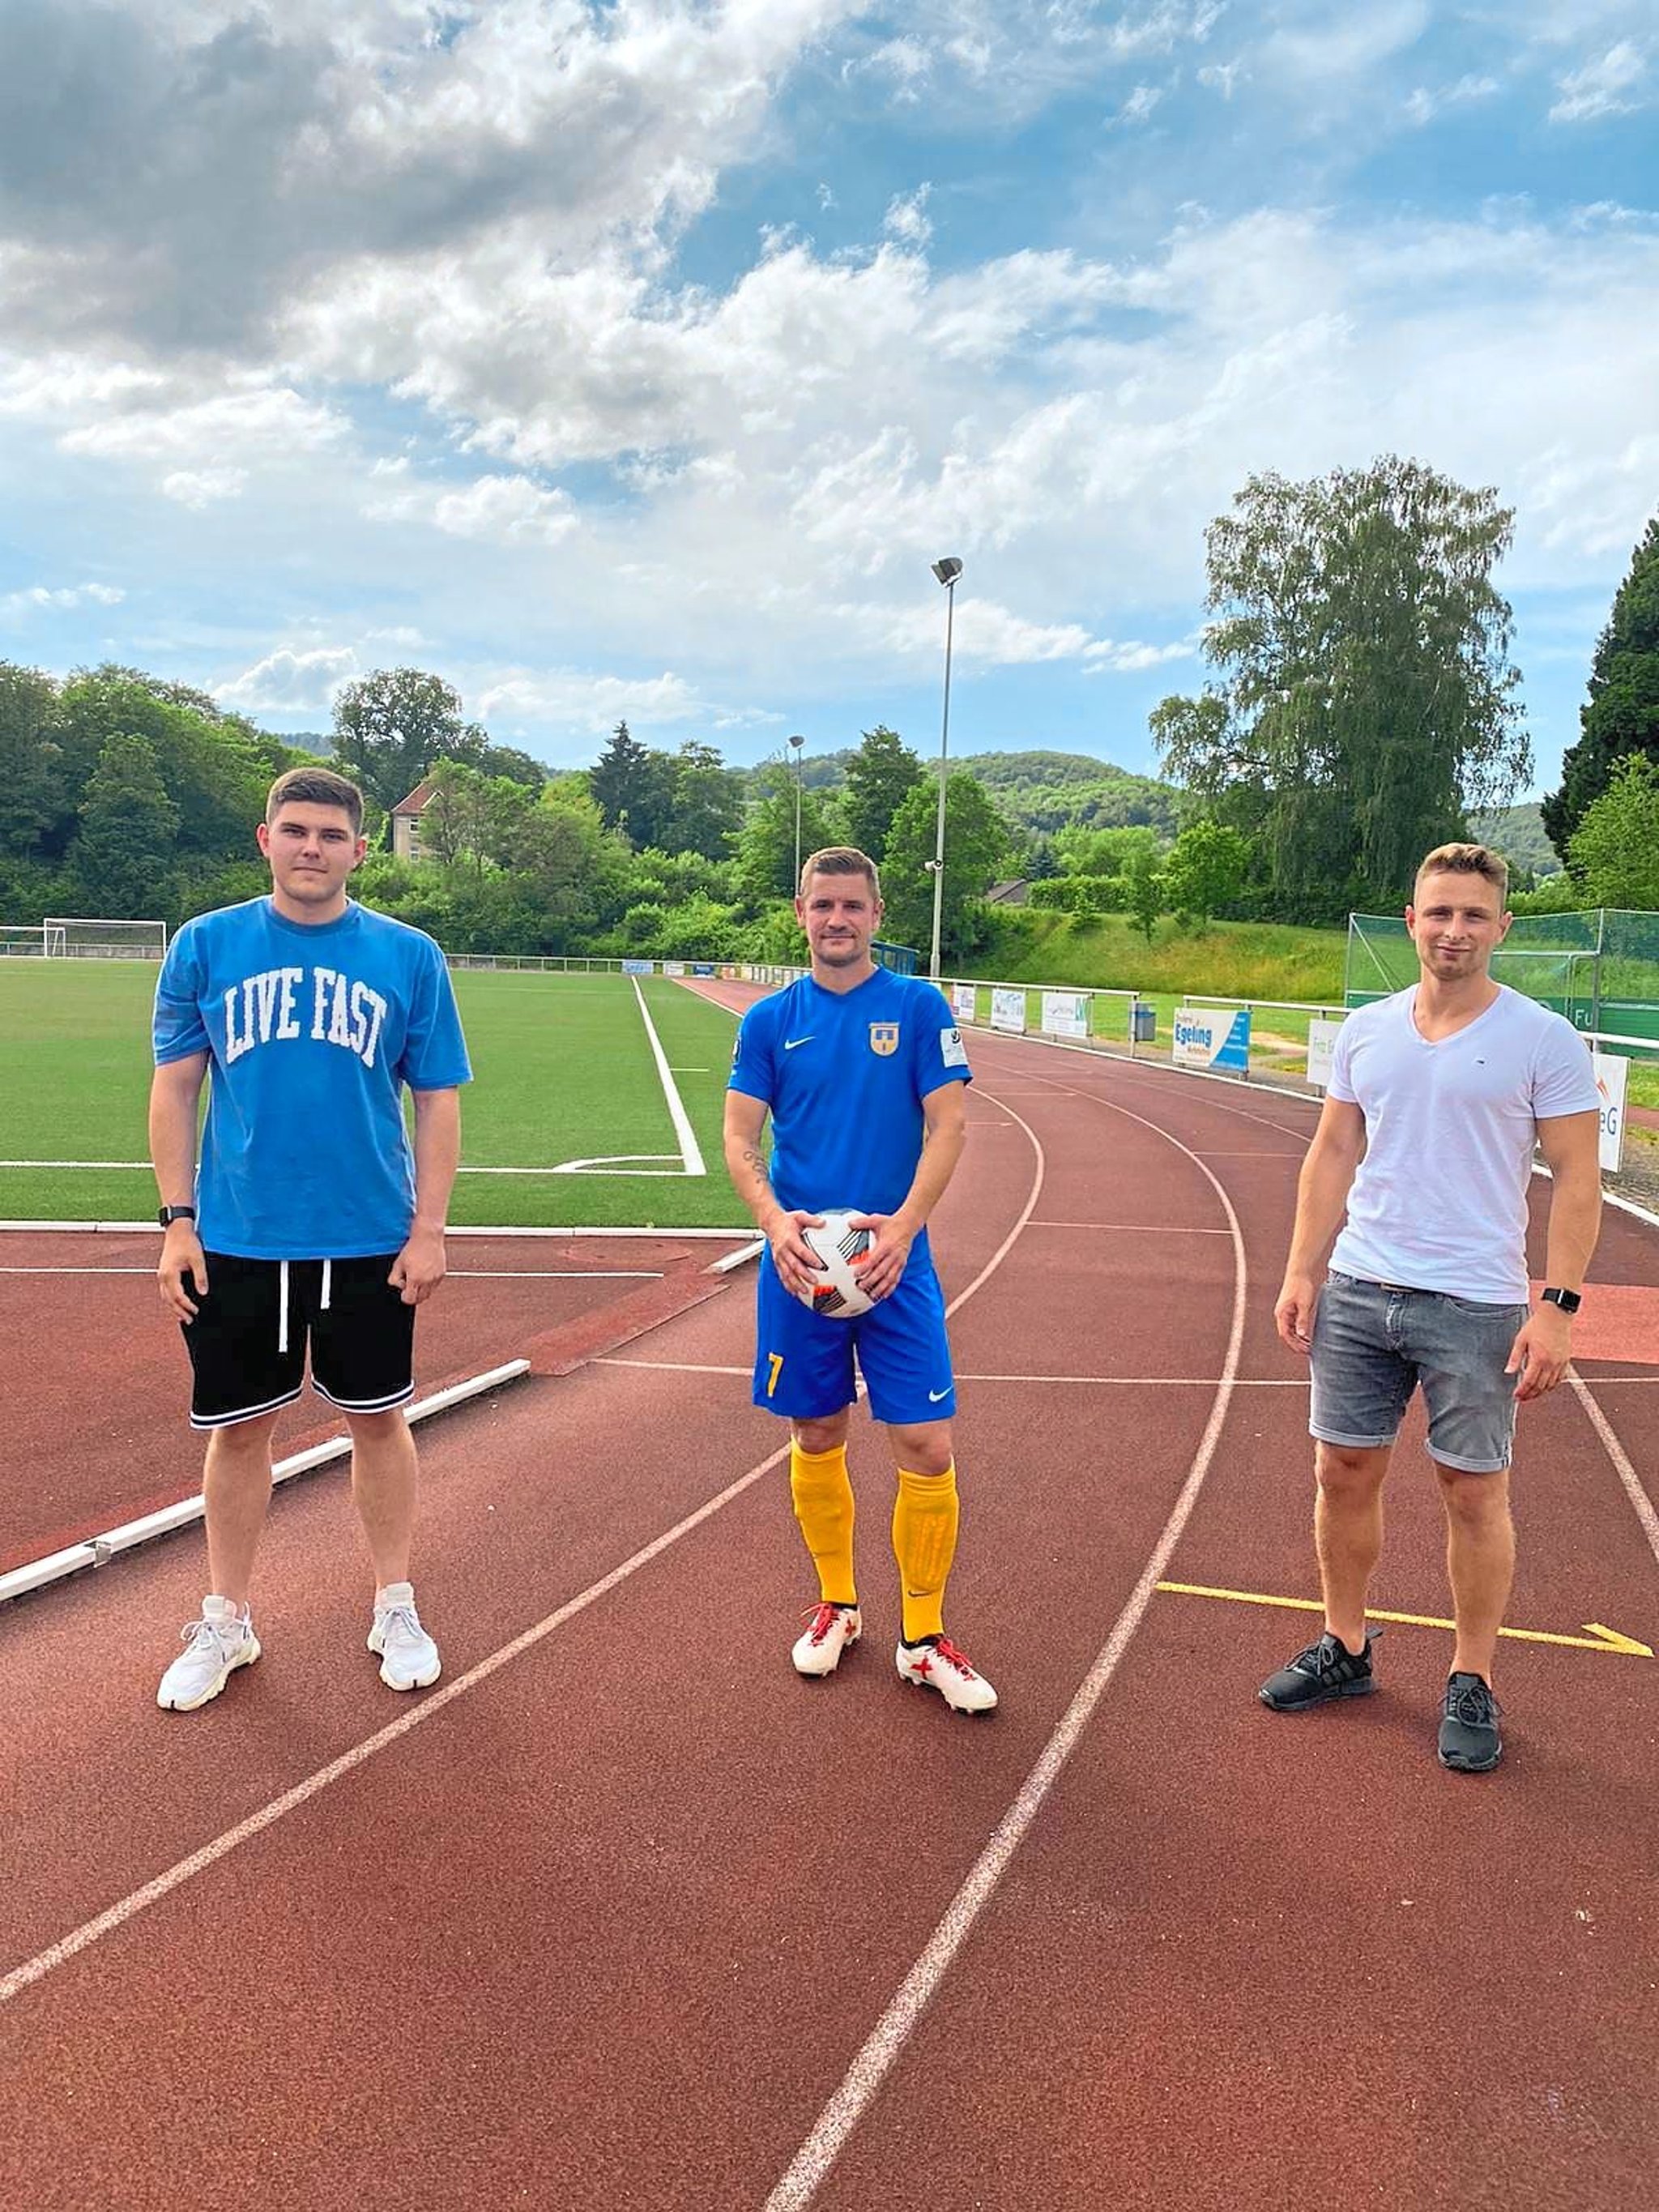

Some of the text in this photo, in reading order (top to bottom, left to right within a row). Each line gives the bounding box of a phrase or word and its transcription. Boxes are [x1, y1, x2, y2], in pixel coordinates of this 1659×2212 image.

[224, 967, 387, 1069] LIVE FAST
[1175, 1023, 1213, 1048] Egeling
[768, 1352, 784, 1398] 7
